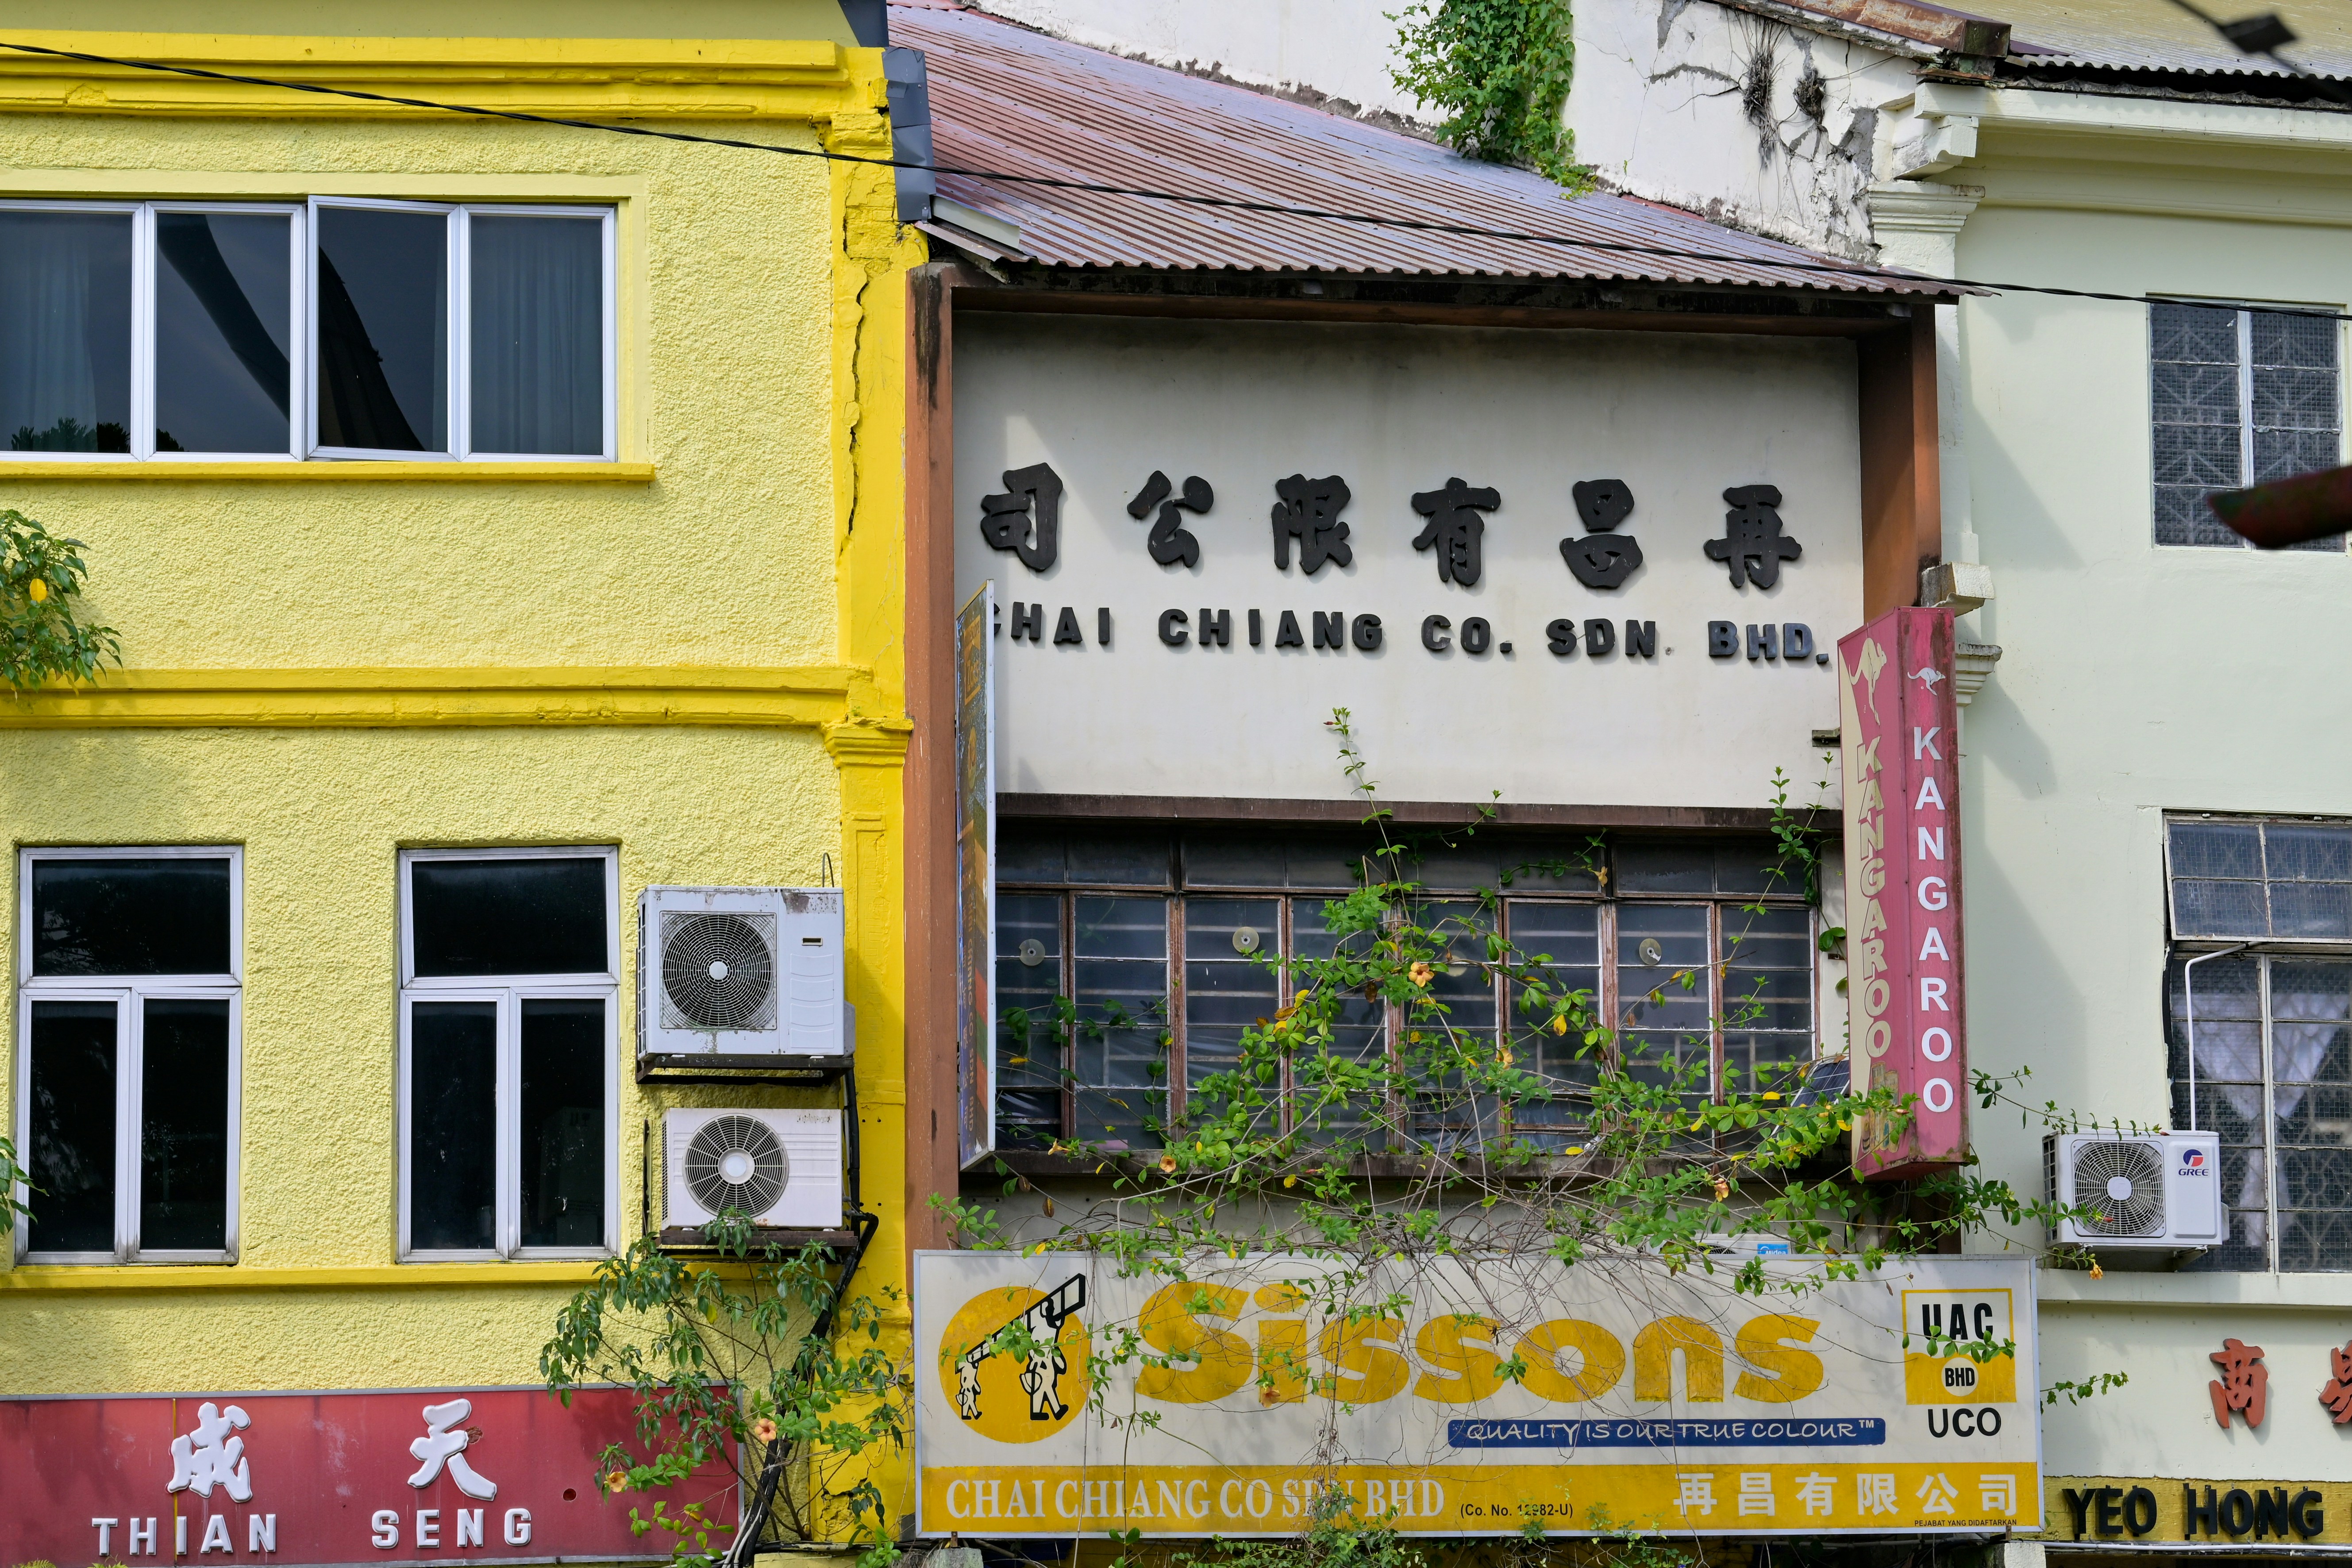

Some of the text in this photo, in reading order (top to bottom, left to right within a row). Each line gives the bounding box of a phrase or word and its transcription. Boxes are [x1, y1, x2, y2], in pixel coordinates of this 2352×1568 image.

[994, 601, 1829, 667] HAI CHIANG CO. SDN BHD.
[1857, 735, 1891, 1058] KANGAROO
[1913, 726, 1953, 1113] KANGAROO
[1134, 1280, 1824, 1407] Sissons
[1921, 1302, 1994, 1341] UAC
[1944, 1367, 1975, 1387] BHD
[1467, 1423, 1579, 1446] QUALITY
[1586, 1424, 1610, 1439] IS
[1617, 1423, 1674, 1439] OUR
[1677, 1423, 1745, 1439] TRUE
[1751, 1423, 1857, 1438] COLOUR
[1927, 1407, 2002, 1438] UCO
[947, 1479, 1045, 1518] CHAI
[1056, 1479, 1211, 1518] CHIANG
[1220, 1479, 1272, 1518] CO
[1364, 1479, 1444, 1517] BHD
[1460, 1503, 1486, 1519] (Co.
[1491, 1504, 1512, 1516] No.
[1673, 1472, 2017, 1517] 再昌有限公司
[2062, 1485, 2324, 1537] YEO HONG
[92, 1508, 531, 1556] THIAN SENG
